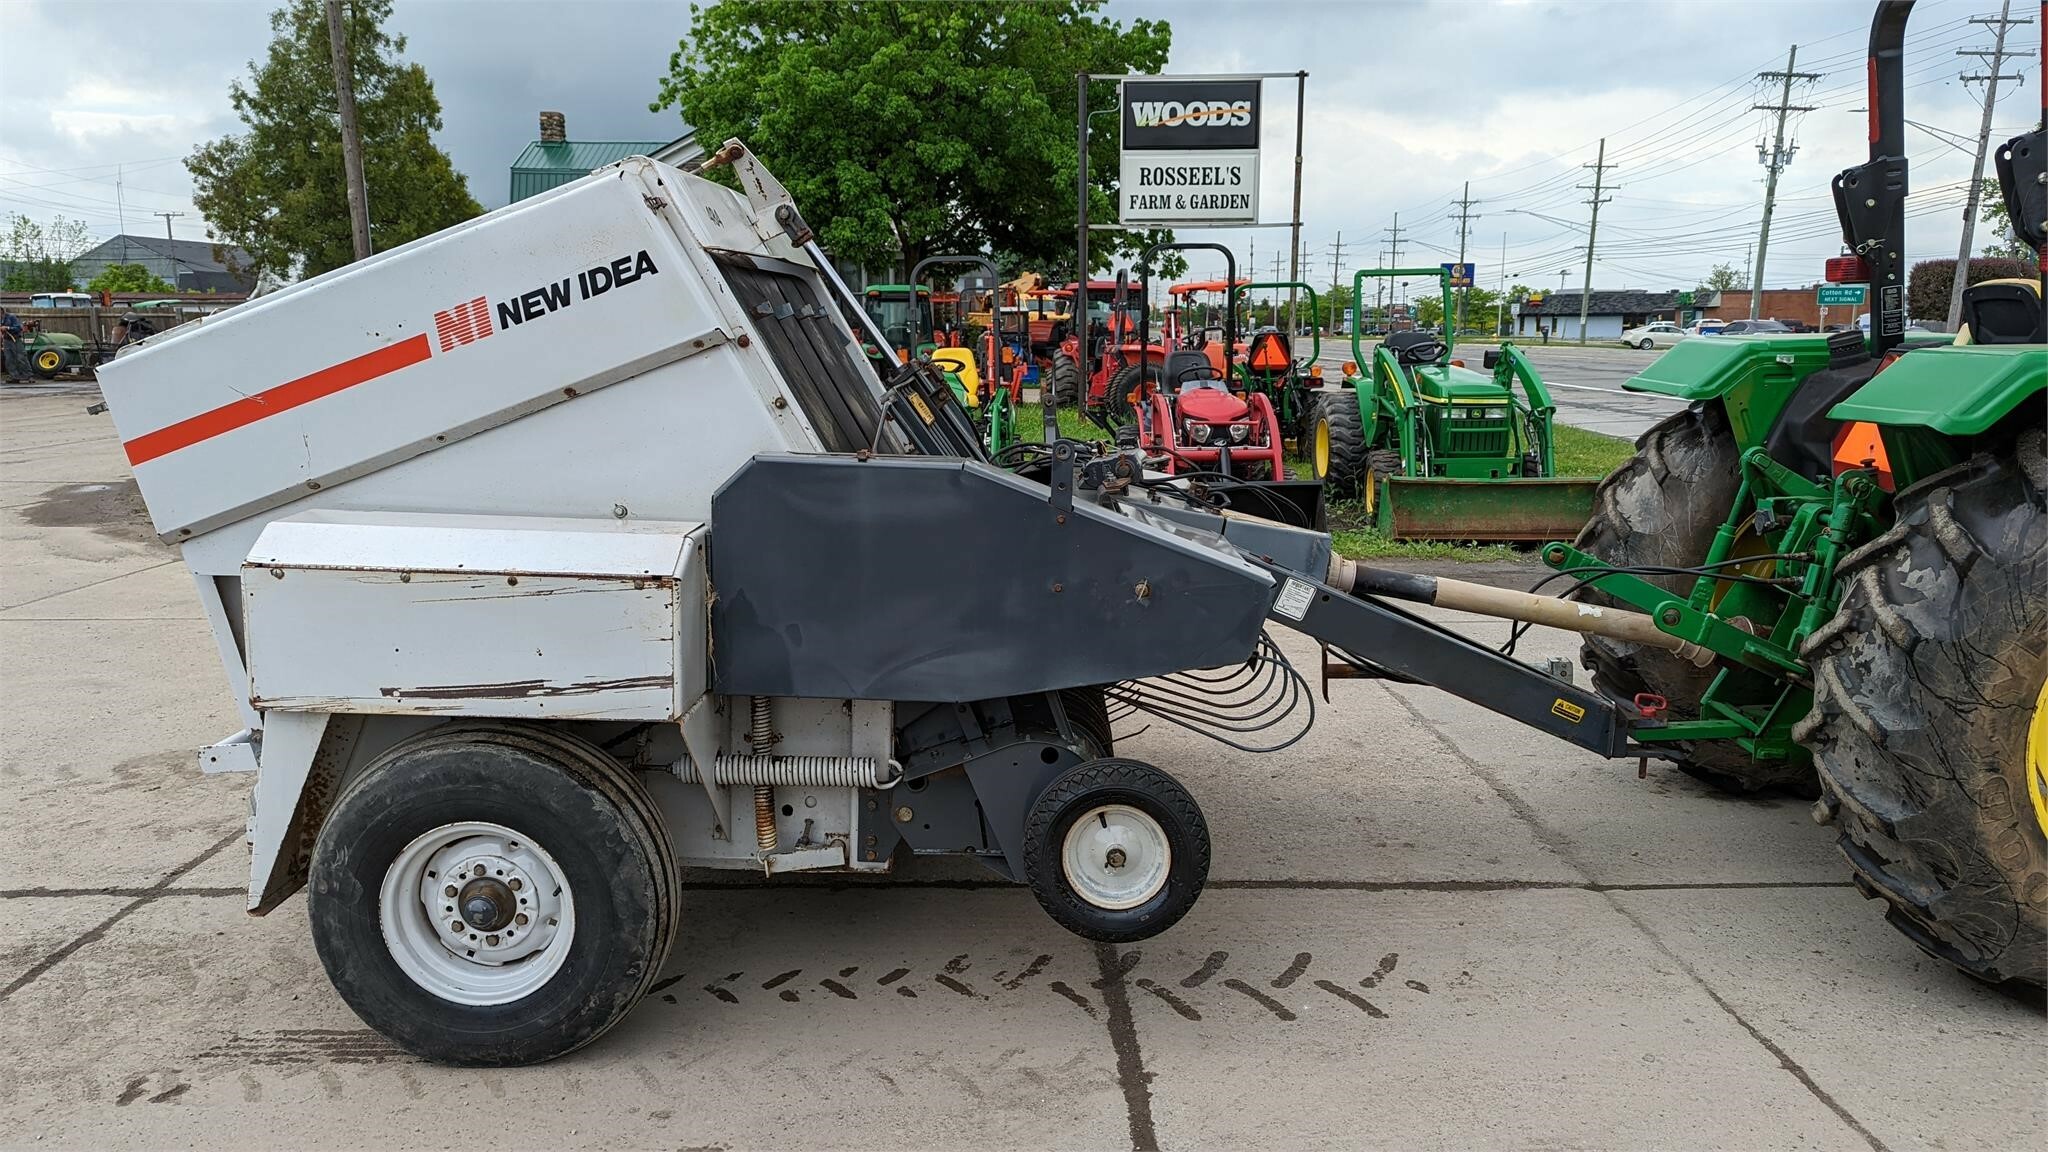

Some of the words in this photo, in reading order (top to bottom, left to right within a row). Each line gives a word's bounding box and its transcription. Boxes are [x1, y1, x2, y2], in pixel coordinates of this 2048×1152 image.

[1131, 101, 1251, 127] WOODS
[1139, 166, 1241, 186] ROSSEEL'S
[1129, 194, 1171, 210] FARM
[1175, 194, 1186, 210] &
[1190, 194, 1250, 209] GARDEN
[496, 278, 571, 330] NEW
[577, 249, 659, 300] IDEA
